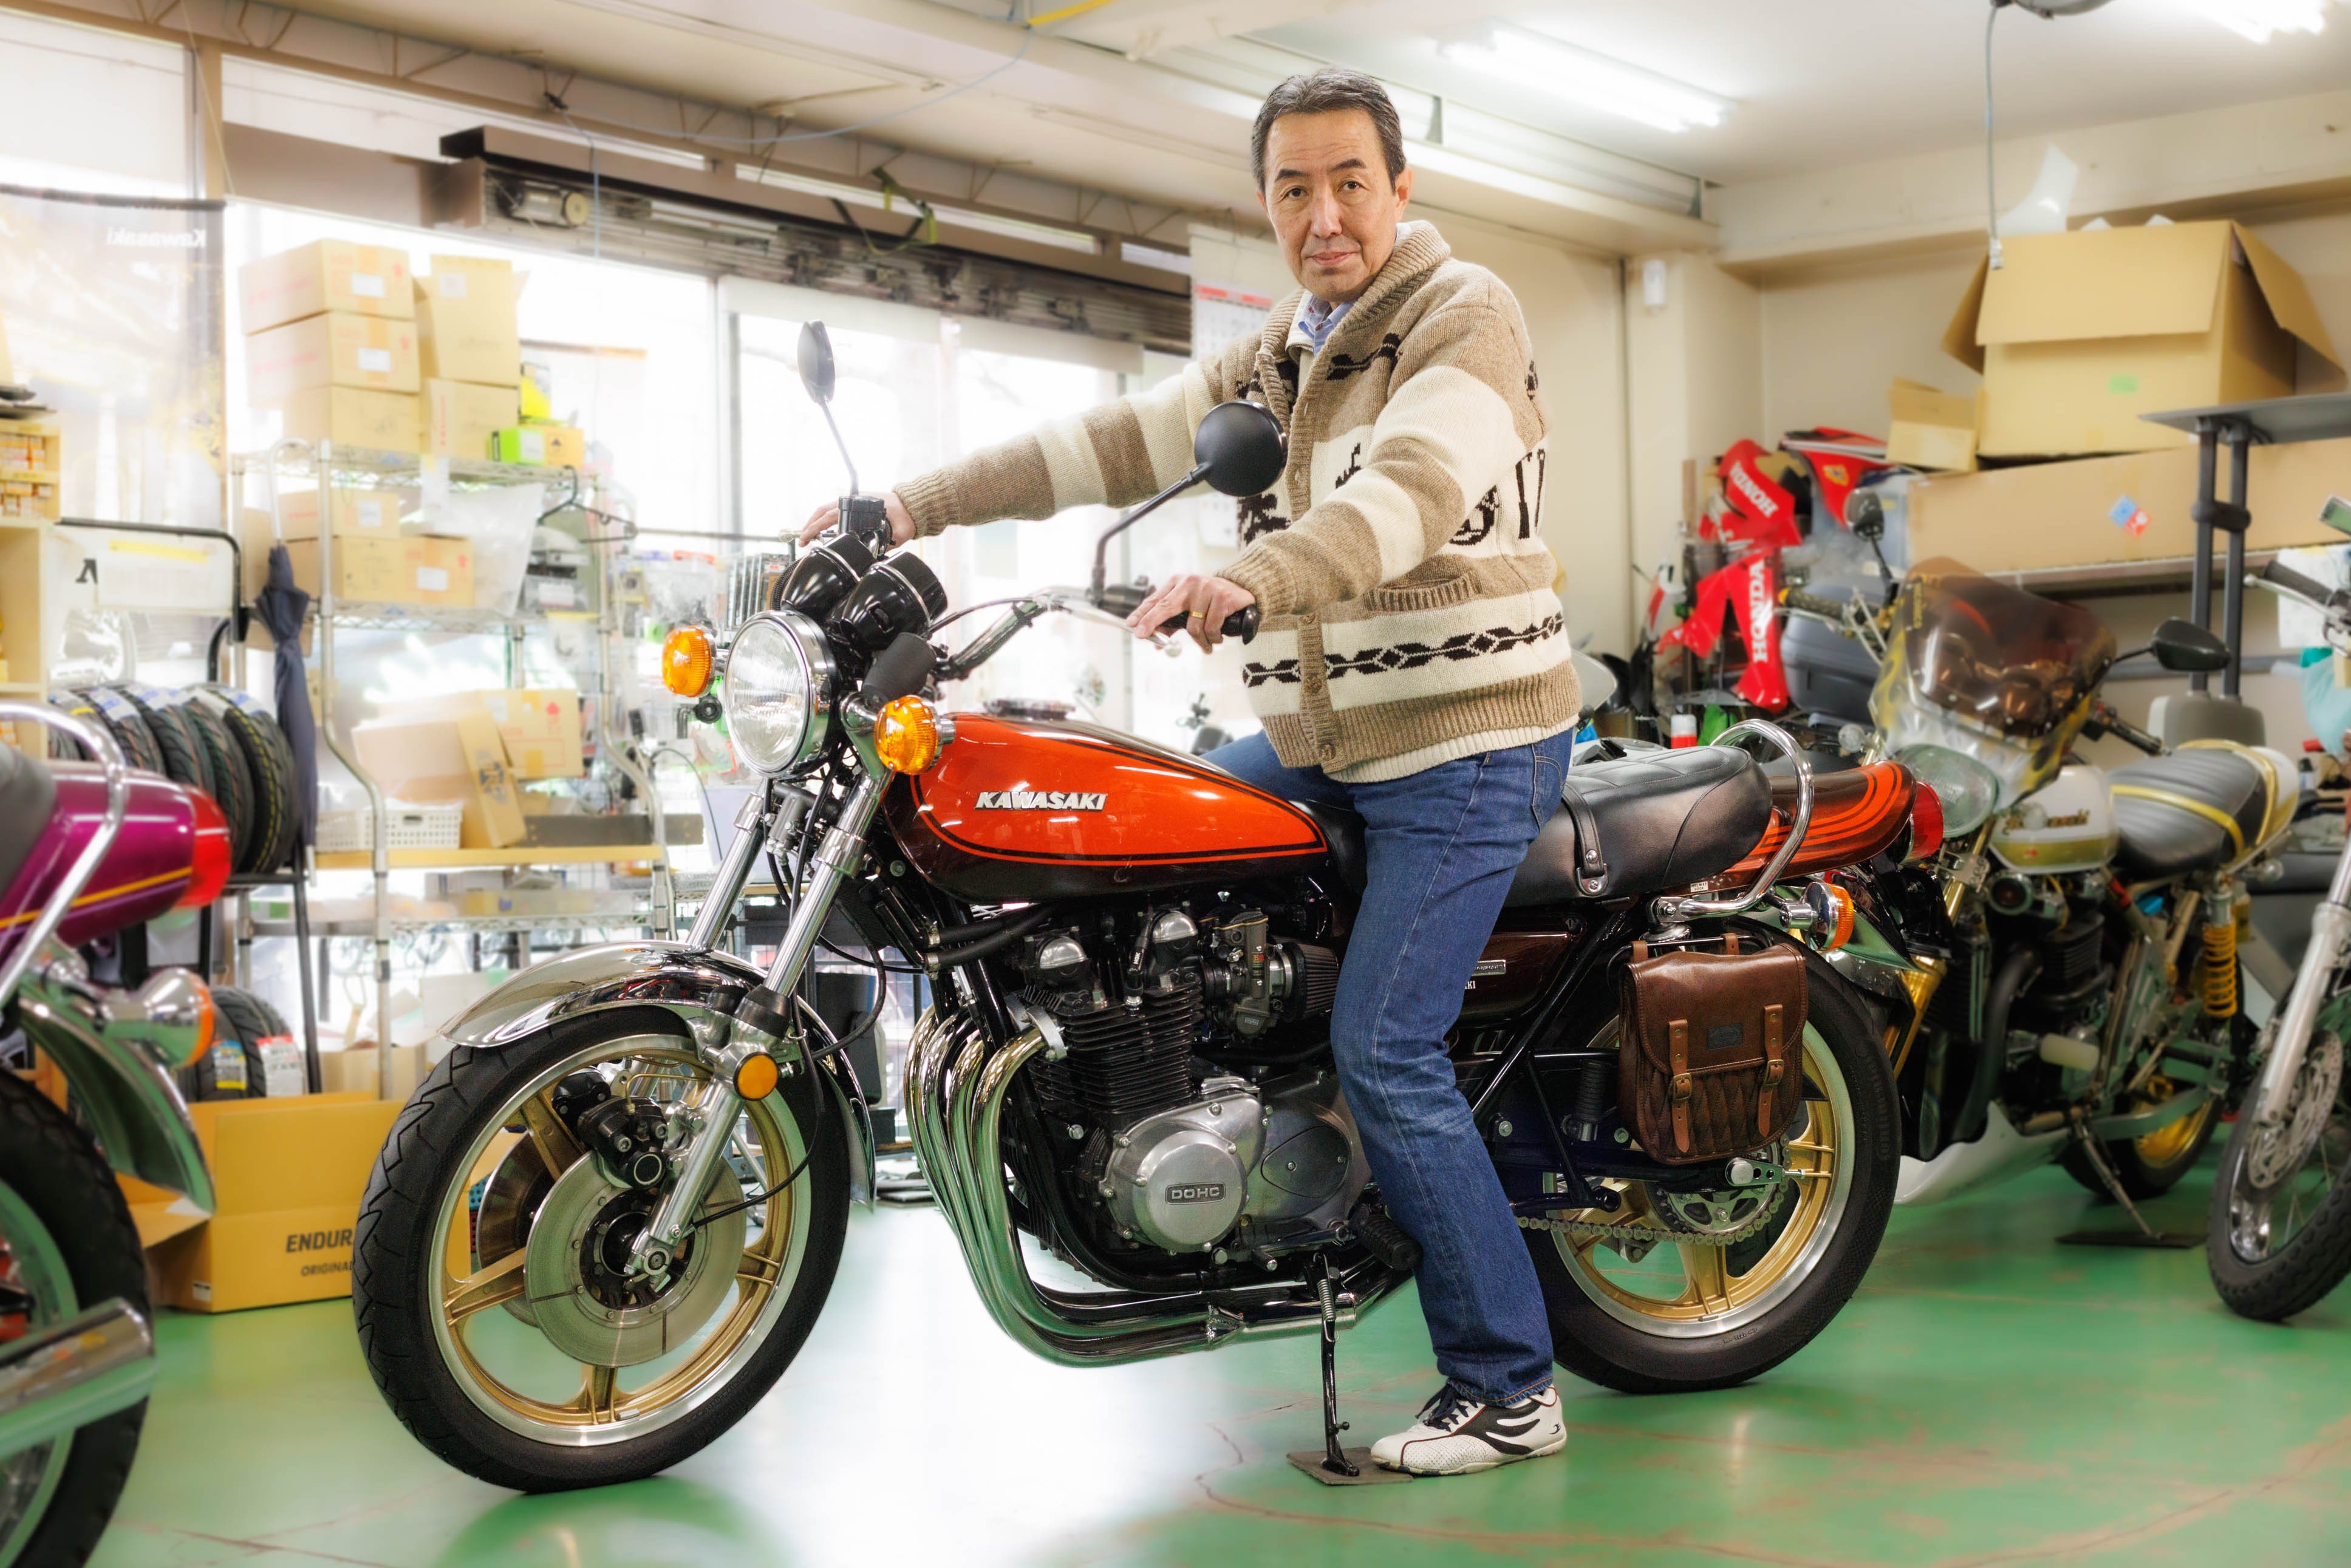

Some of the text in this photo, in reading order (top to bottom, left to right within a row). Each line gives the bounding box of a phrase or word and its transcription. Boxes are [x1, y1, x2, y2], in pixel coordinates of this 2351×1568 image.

[1730, 460, 1779, 519] HONDA
[1749, 560, 1769, 663] HONDA
[975, 791, 1108, 811] KAWASAKI
[1171, 1187, 1220, 1200] DOHC
